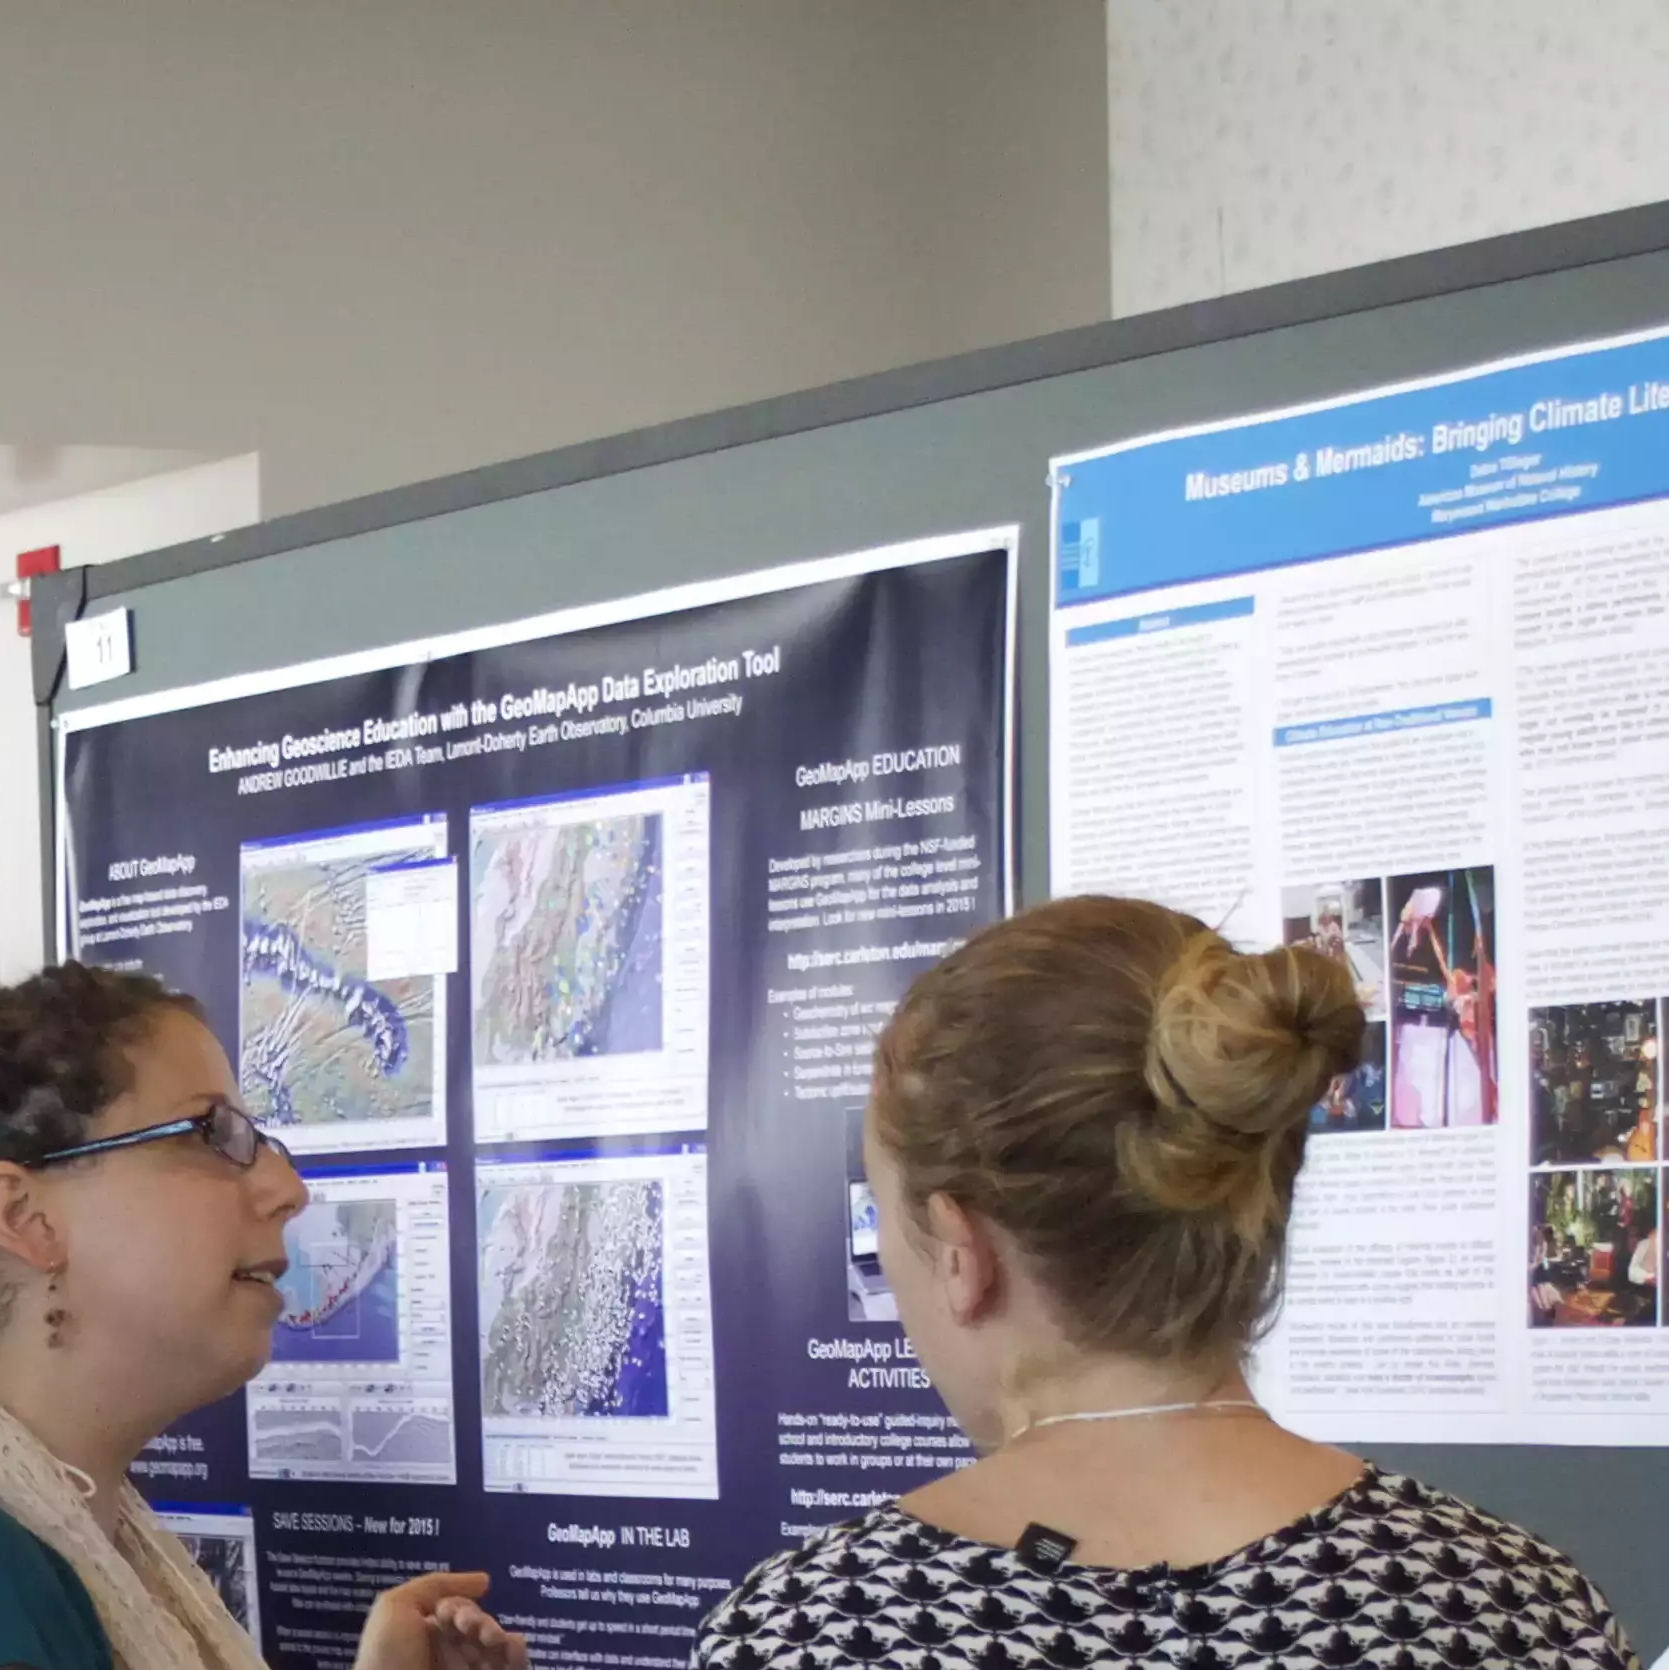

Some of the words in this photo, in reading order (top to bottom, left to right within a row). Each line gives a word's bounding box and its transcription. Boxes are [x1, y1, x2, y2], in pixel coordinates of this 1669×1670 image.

[1186, 463, 1288, 501] Museums
[1293, 453, 1310, 482] &
[1316, 432, 1425, 478] Mermaids:
[1432, 413, 1524, 454] Bringing
[1529, 392, 1622, 433] Climate
[209, 741, 280, 773] Enhancing
[282, 727, 360, 759] Geoscience
[363, 711, 438, 745] Education
[441, 703, 468, 731] with
[471, 699, 497, 725] the
[501, 681, 598, 720] GeoMapApp
[602, 675, 640, 704] Data
[643, 657, 739, 698] Exploration
[742, 646, 780, 678] Tool
[238, 771, 282, 795] ANDREW
[284, 759, 348, 787] GOODWILLIE
[350, 757, 366, 776] and
[368, 754, 383, 772] the
[529, 722, 558, 746] Earth
[561, 714, 628, 740] Observatory,
[631, 704, 684, 729] Columbia
[687, 693, 743, 719] University
[796, 759, 869, 786] GeoMapApp
[872, 745, 960, 775] EDUCATION
[800, 803, 862, 830] MARGINS
[865, 796, 955, 821] Mini-Lessons
[807, 1338, 892, 1363] GeoMapApp
[848, 1368, 930, 1389] ACTIVITIES
[272, 1512, 299, 1530] SAVE
[301, 1512, 354, 1533] SESSIONS
[364, 1516, 388, 1534] New
[389, 1515, 407, 1535] for
[408, 1517, 433, 1536] 2015
[547, 1522, 616, 1548] GeoMapApp
[620, 1527, 635, 1545] IN
[636, 1527, 664, 1547] THE
[665, 1528, 690, 1548] LAB
